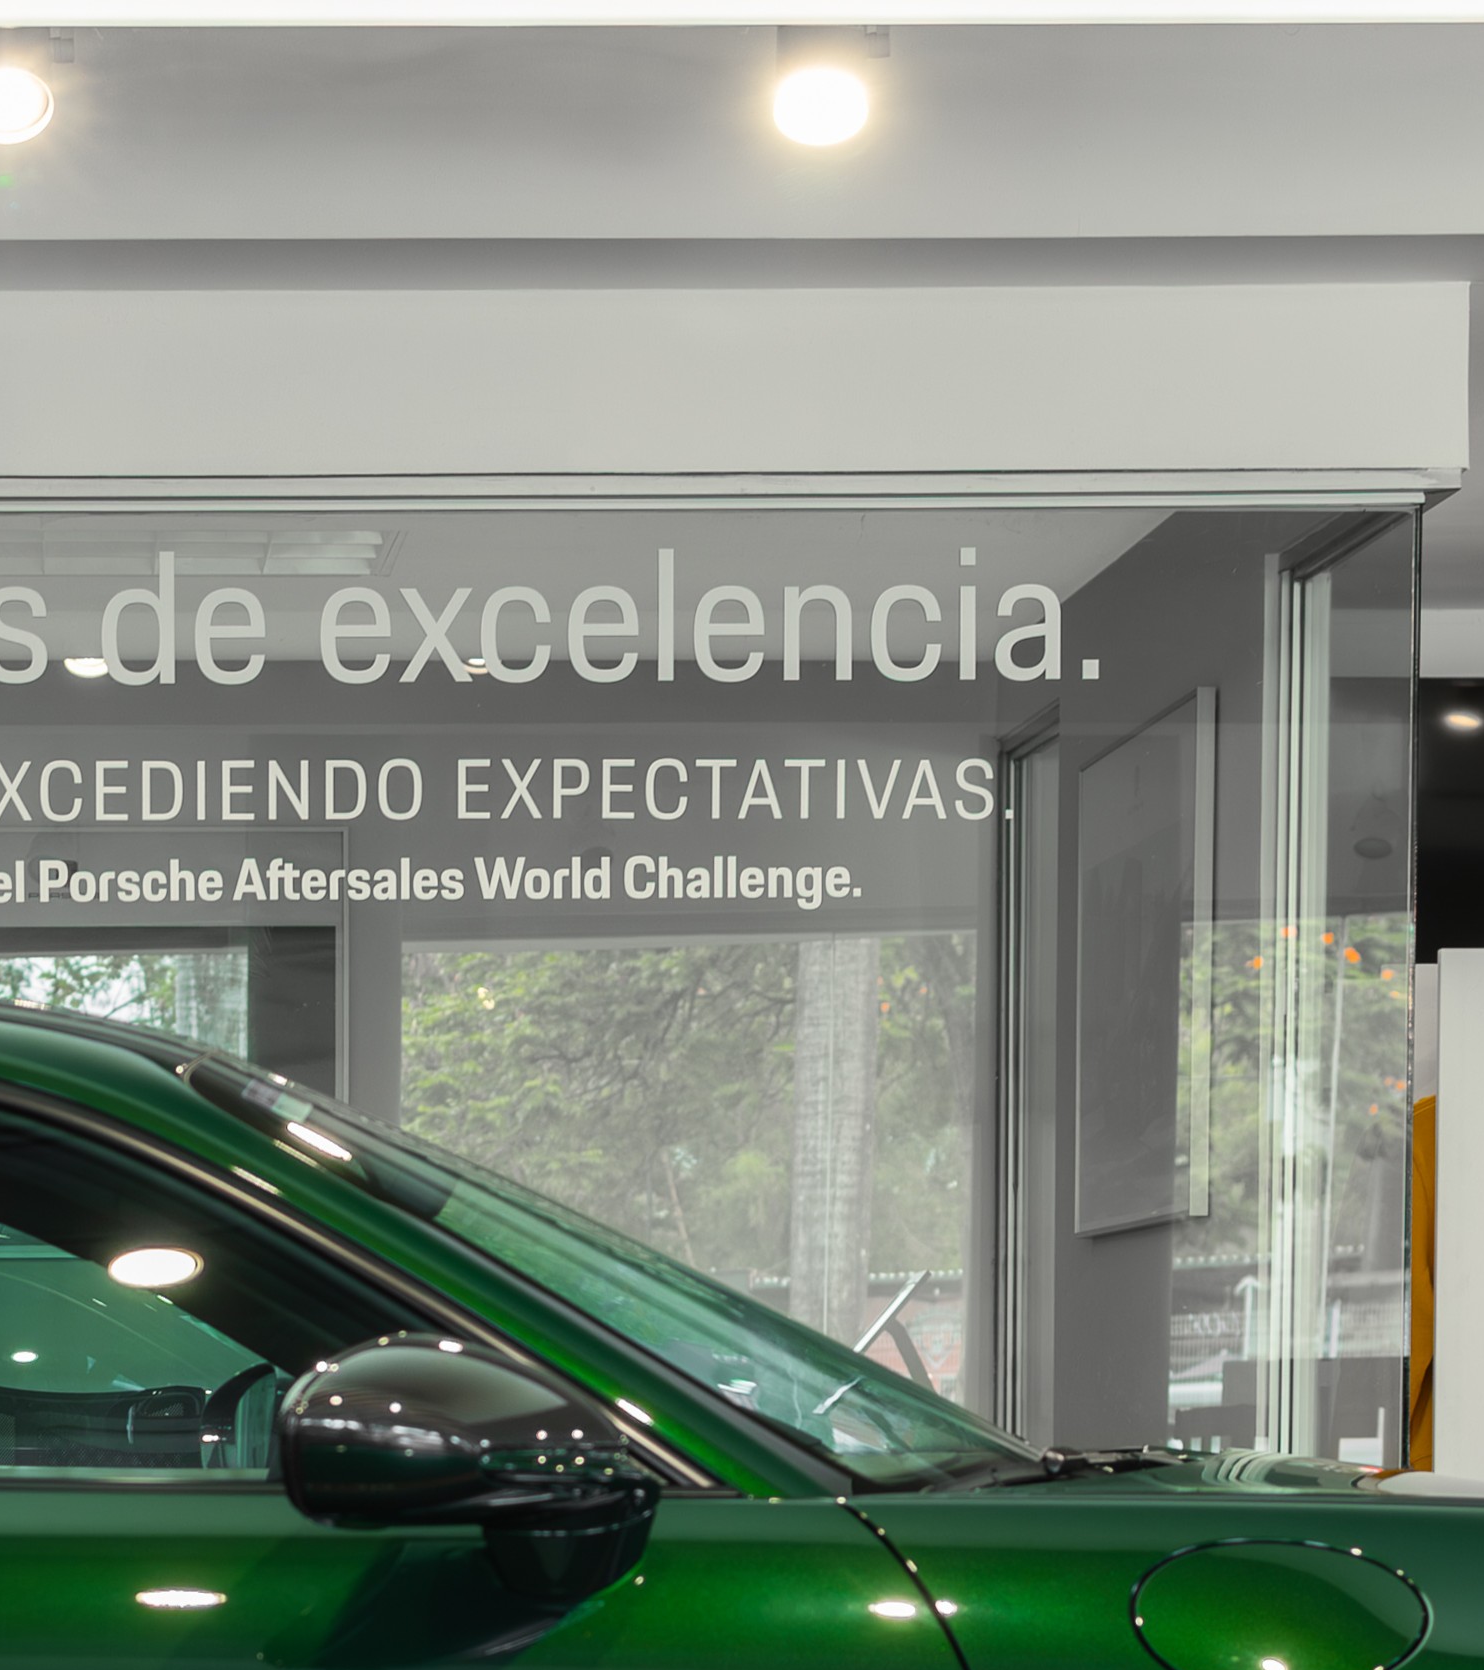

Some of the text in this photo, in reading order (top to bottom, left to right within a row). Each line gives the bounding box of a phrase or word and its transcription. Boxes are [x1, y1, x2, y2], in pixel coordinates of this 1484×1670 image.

[100, 550, 267, 686] de
[319, 546, 1101, 685] excelencia.
[456, 757, 1015, 821] EXPECTATIVAS.
[38, 858, 224, 903] Porsche
[232, 857, 465, 902] Aftersales
[474, 856, 611, 900] World
[622, 855, 863, 910] Challenge.
